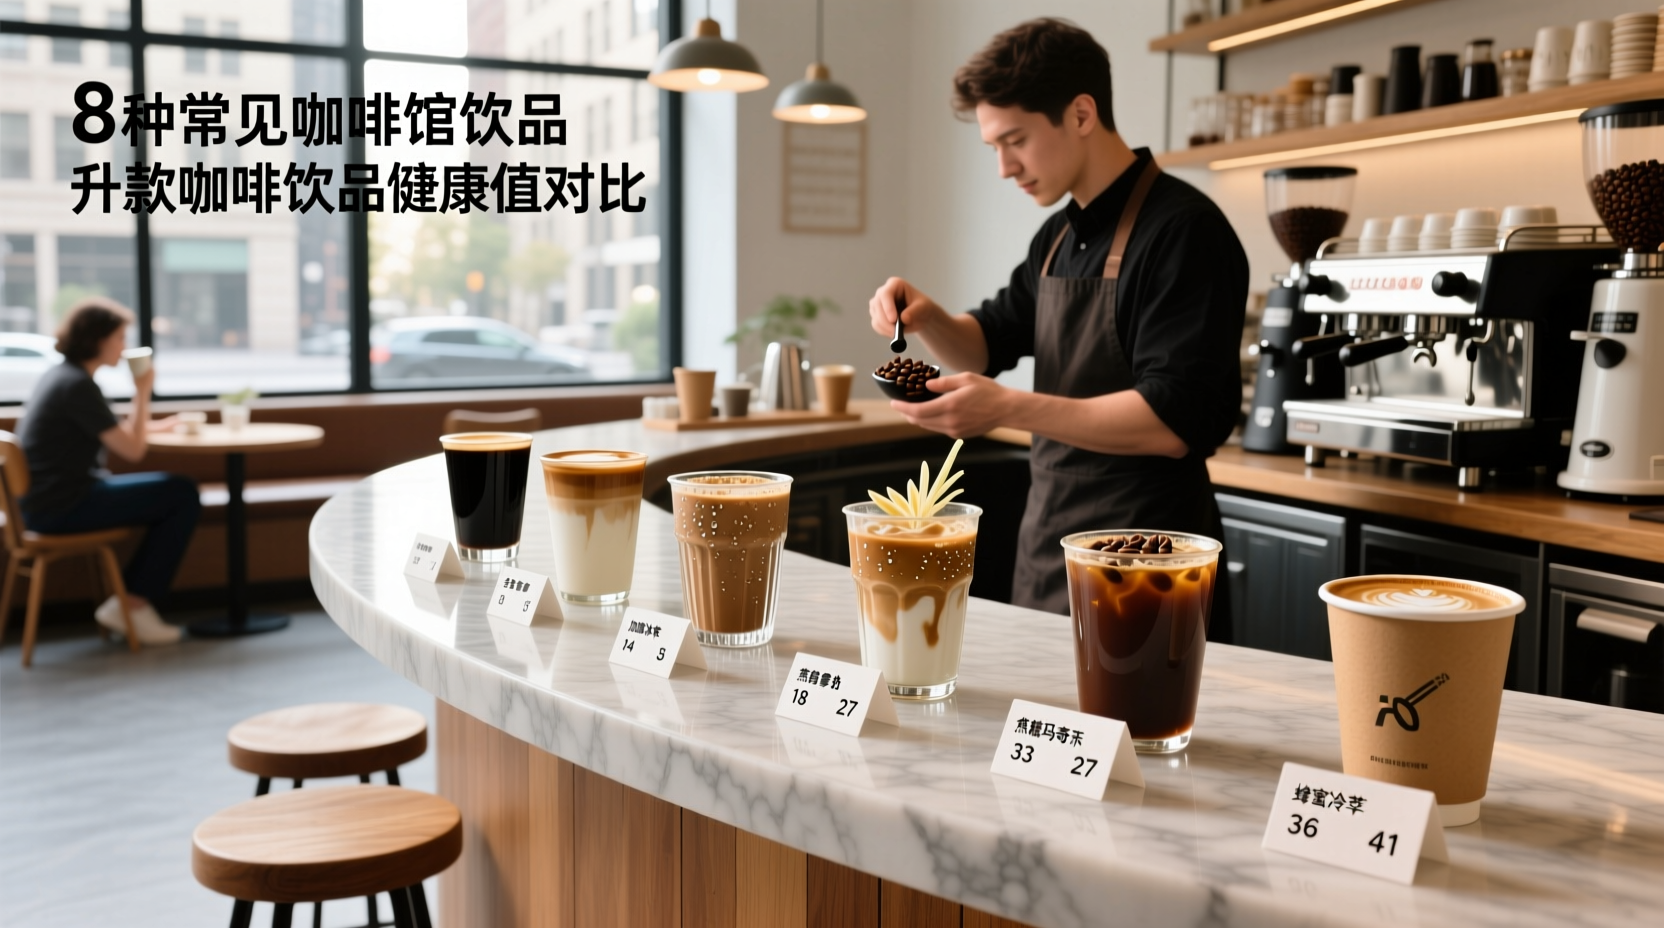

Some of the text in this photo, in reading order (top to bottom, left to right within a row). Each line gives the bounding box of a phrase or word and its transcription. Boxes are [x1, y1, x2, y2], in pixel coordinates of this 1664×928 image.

[622, 638, 635, 653] 14
[792, 688, 859, 718] 18 27
[1010, 742, 1098, 778] 33 27
[1287, 813, 1398, 856] 36 41
